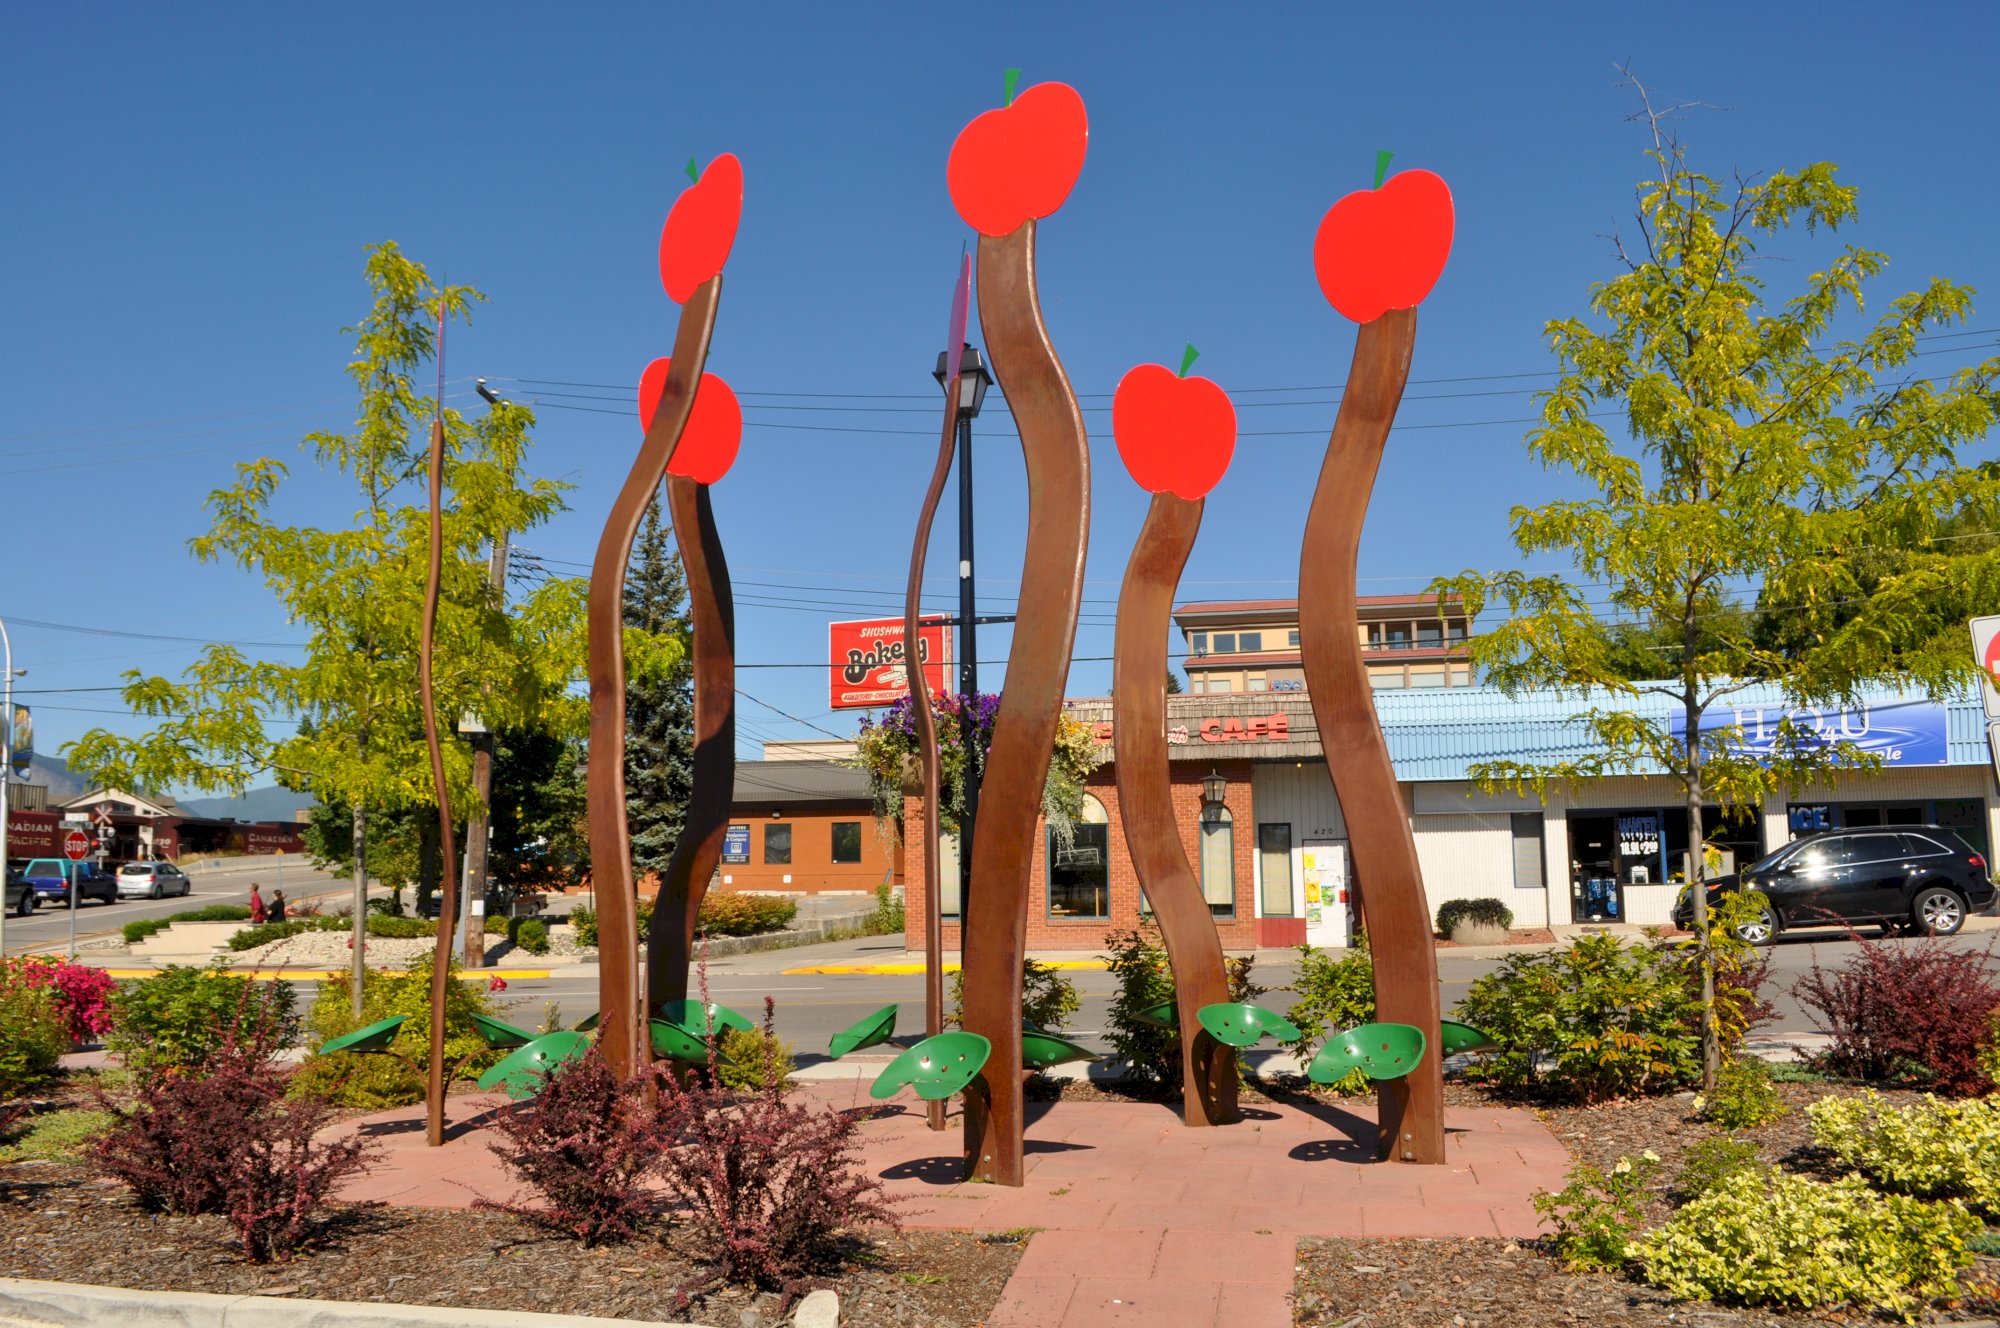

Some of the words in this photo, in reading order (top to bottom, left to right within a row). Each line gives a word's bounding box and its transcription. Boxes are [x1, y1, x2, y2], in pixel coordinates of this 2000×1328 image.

[860, 626, 905, 638] SHUSHWA
[844, 637, 928, 684] Bakey
[1199, 711, 1289, 743] CAFÉ
[1789, 806, 1830, 830] ICE
[7, 822, 53, 833] NADIAN
[1313, 828, 1334, 836] 420
[248, 833, 294, 844] CANADIAN
[66, 840, 88, 852] STOP
